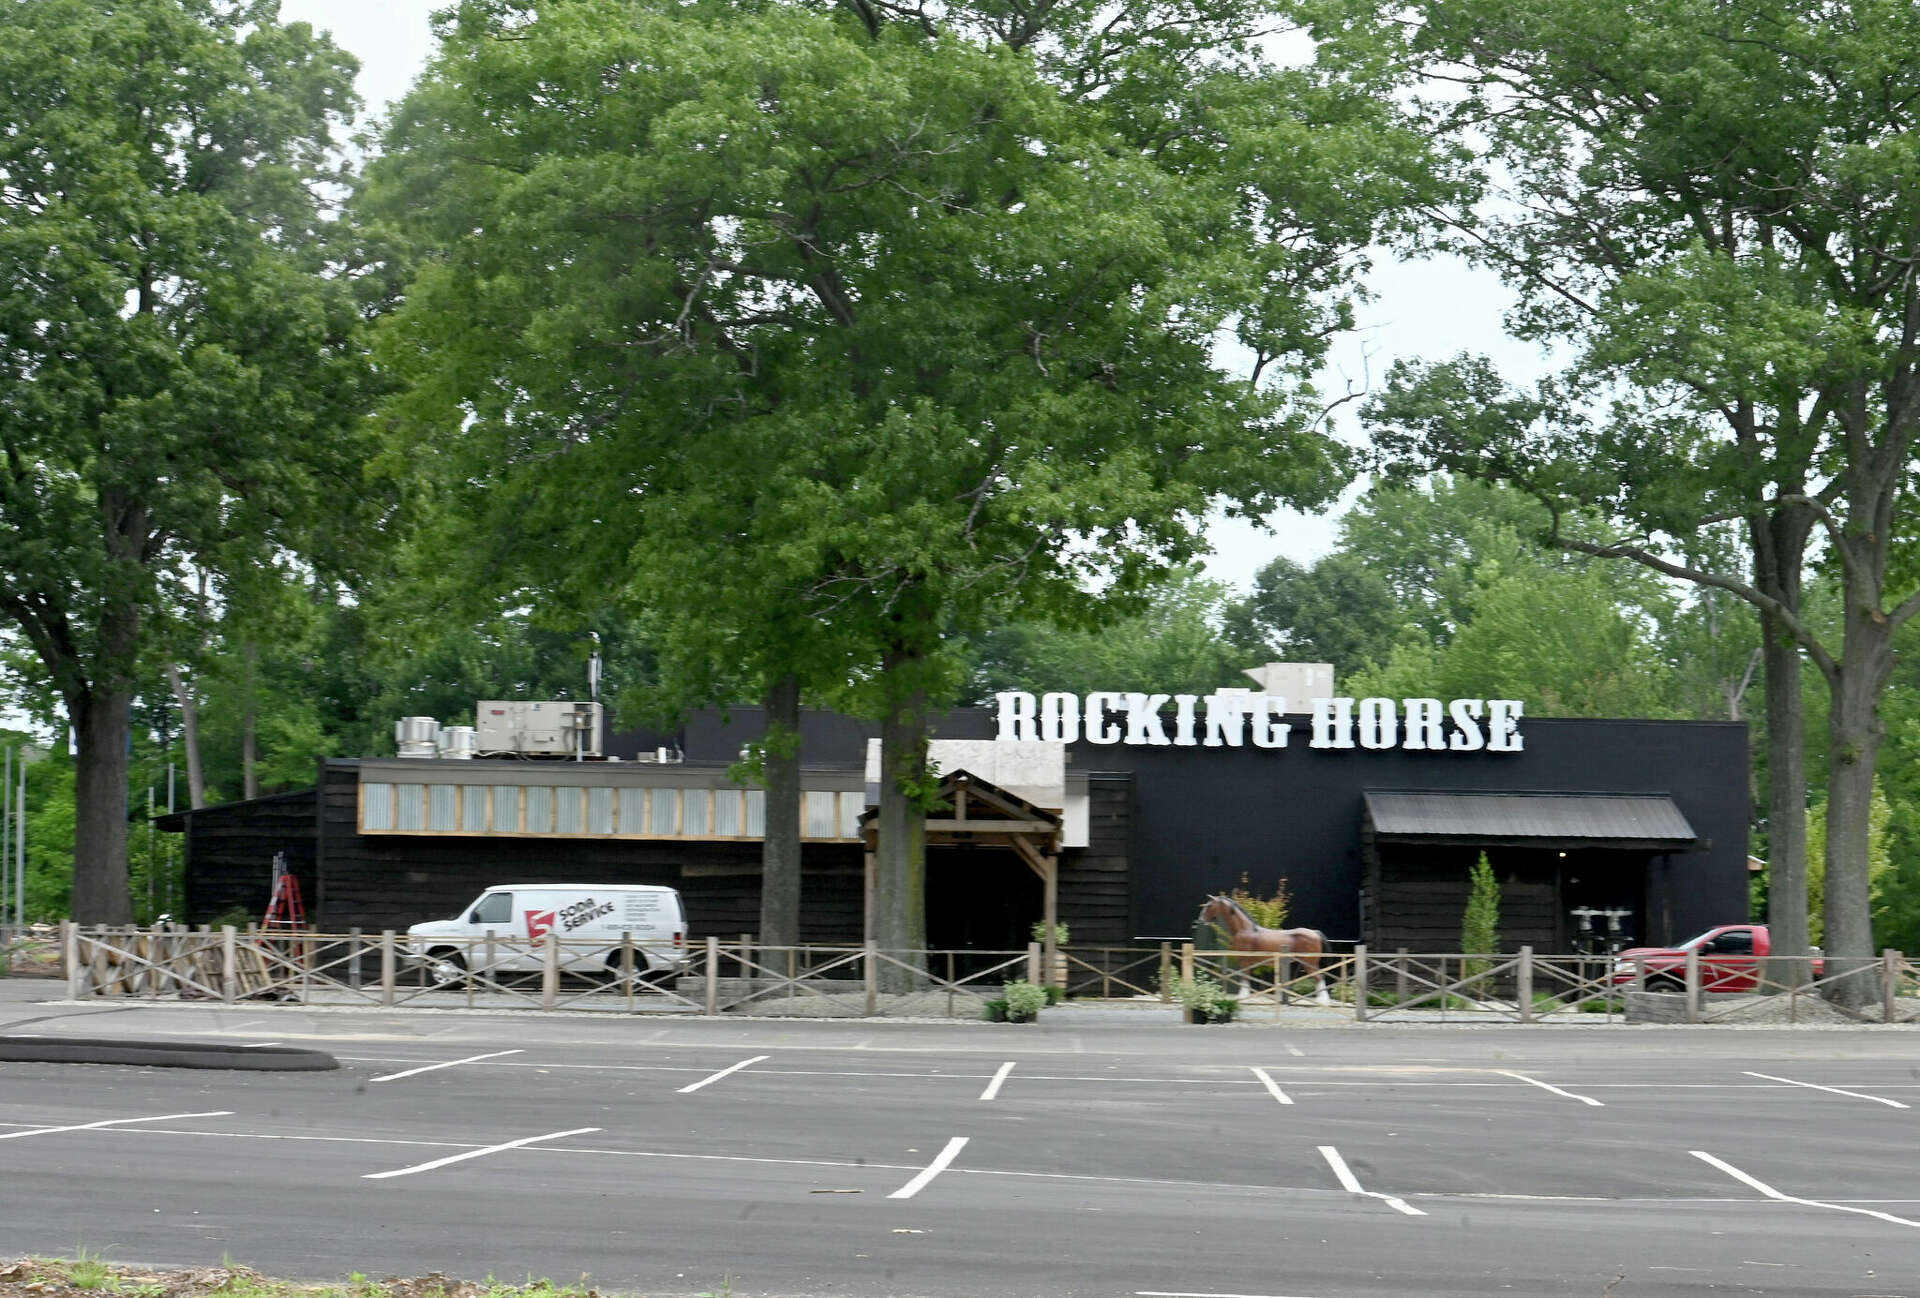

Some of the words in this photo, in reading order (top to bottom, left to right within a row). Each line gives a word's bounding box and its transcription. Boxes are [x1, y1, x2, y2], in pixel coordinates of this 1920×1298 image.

[995, 692, 1292, 748] ROCKING
[1308, 697, 1525, 752] HORSE
[559, 898, 595, 920] SODA
[564, 902, 615, 932] SERVICE
